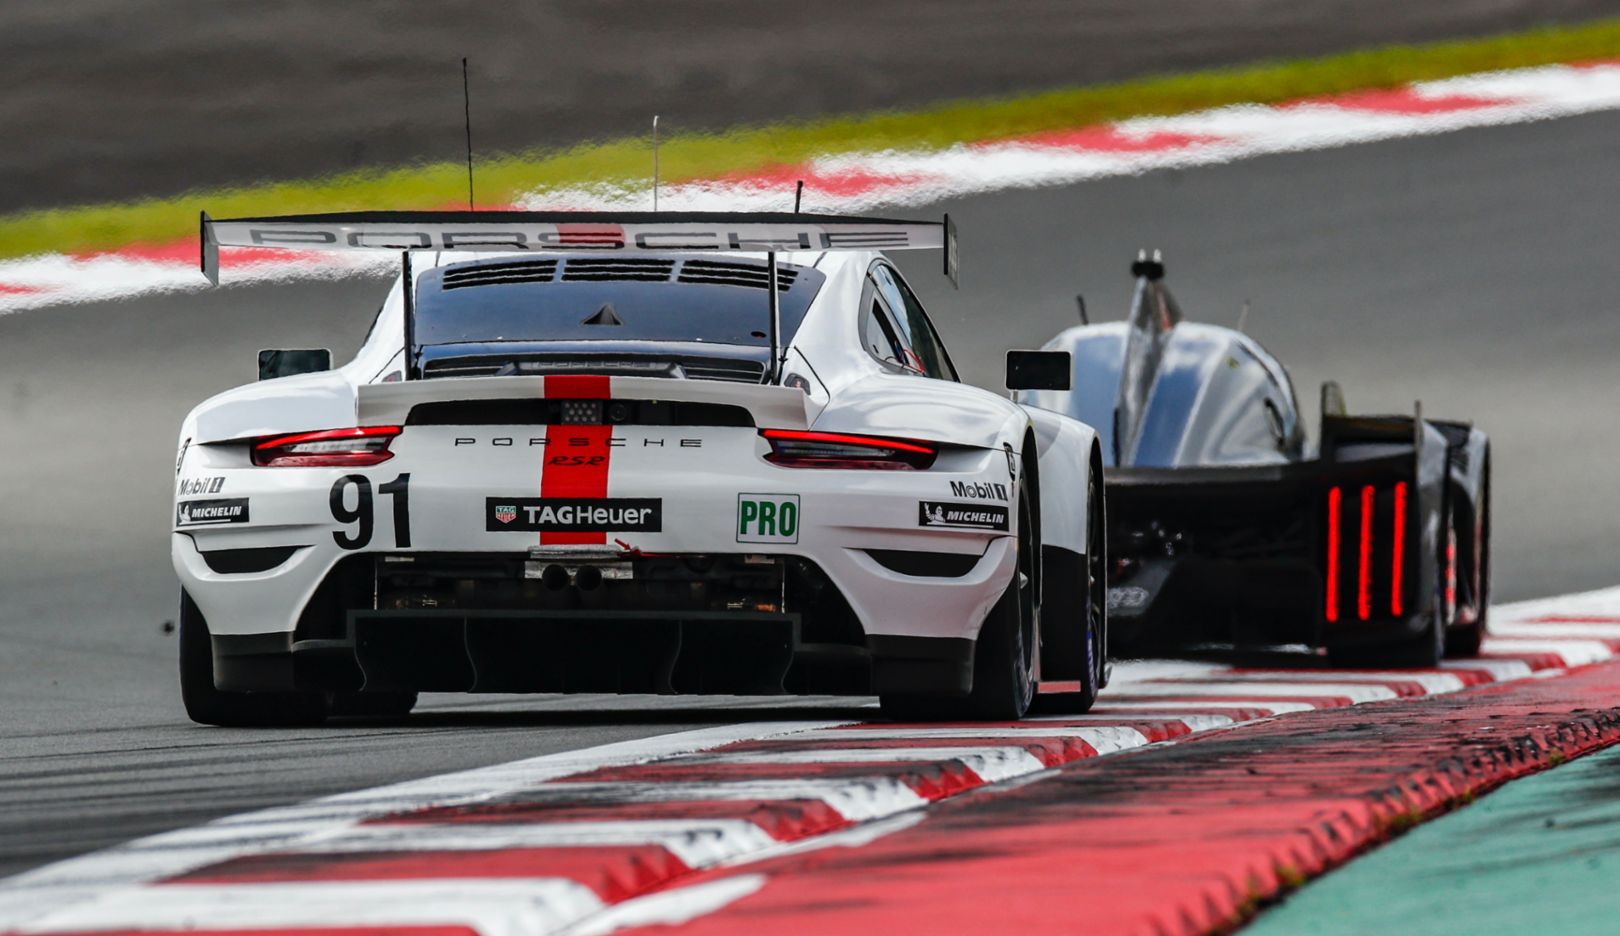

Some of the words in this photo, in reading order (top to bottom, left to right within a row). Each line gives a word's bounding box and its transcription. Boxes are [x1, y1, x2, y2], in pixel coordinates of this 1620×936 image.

[249, 228, 911, 249] PORSCHE
[455, 437, 702, 448] PORSCHE
[178, 477, 211, 496] Mobil
[950, 480, 996, 500] Mobil
[191, 505, 242, 518] MICHELIN
[329, 473, 411, 550] 91
[740, 500, 797, 537] PRO
[946, 510, 1005, 525] MICHELIN
